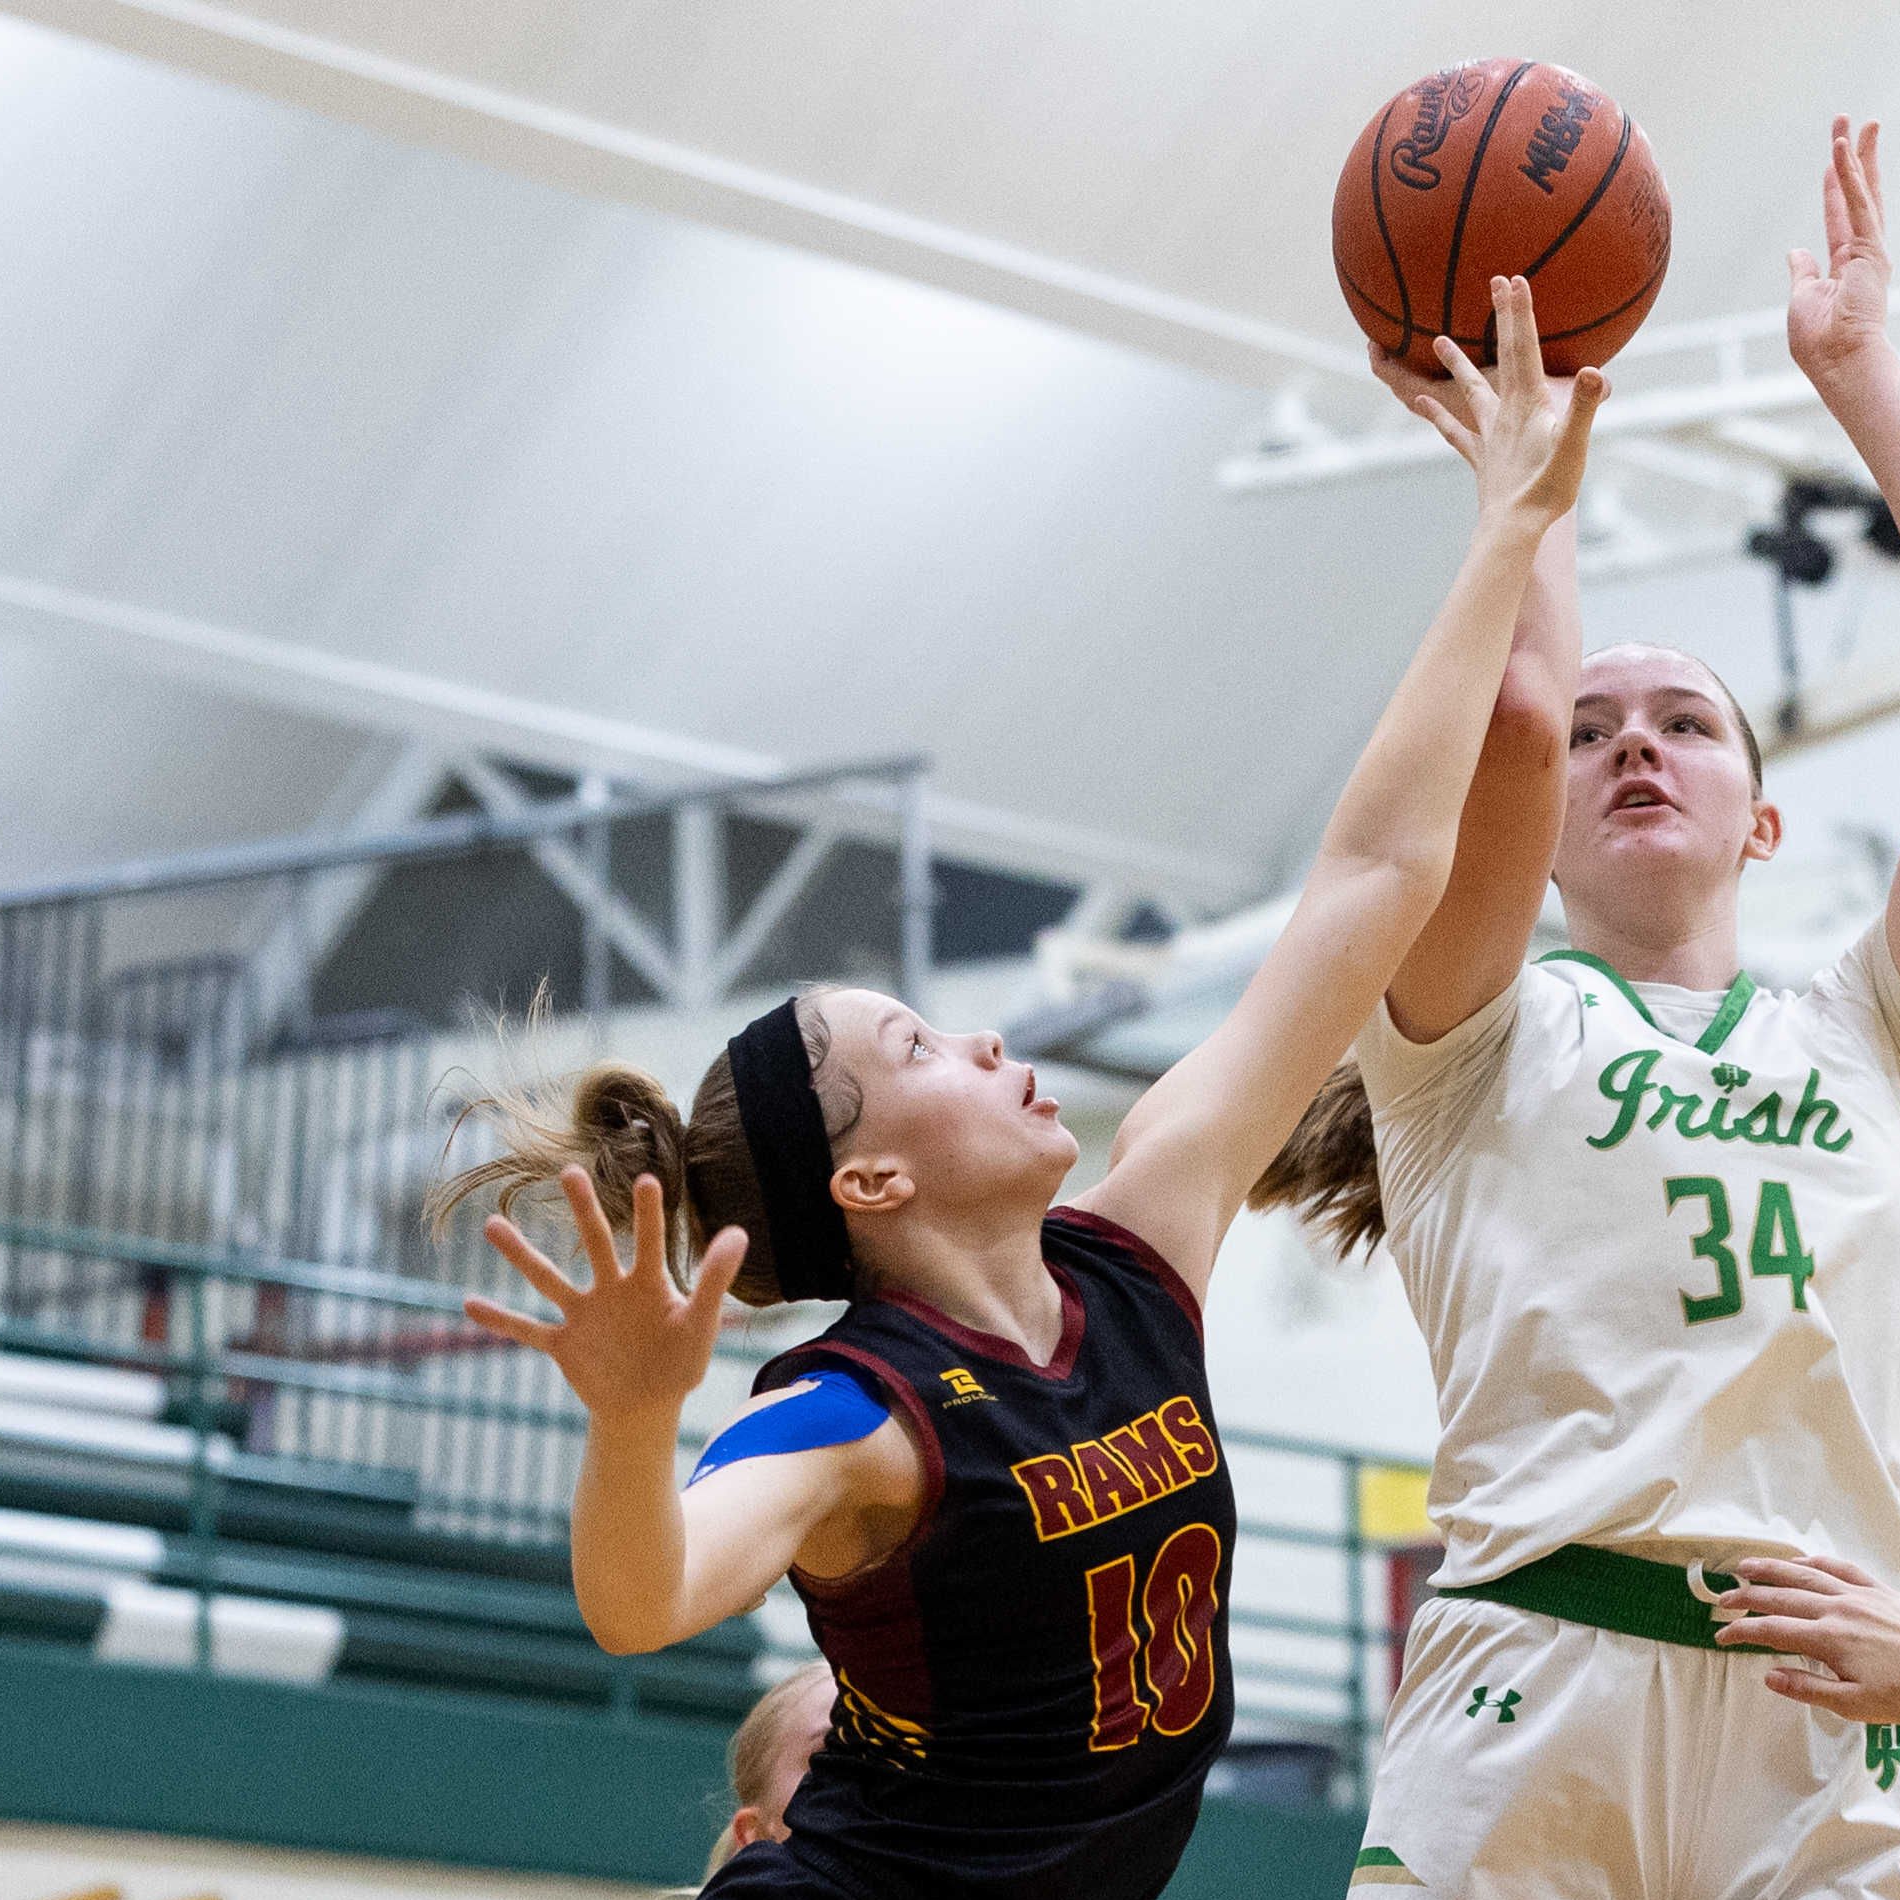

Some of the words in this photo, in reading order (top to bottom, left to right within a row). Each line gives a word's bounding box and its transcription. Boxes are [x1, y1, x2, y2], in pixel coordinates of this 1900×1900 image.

[1585, 1049, 1855, 1153] Irish
[1662, 1174, 1816, 1328] 34
[1010, 1395, 1218, 1543] RAMS
[1085, 1522, 1222, 1753] 10
